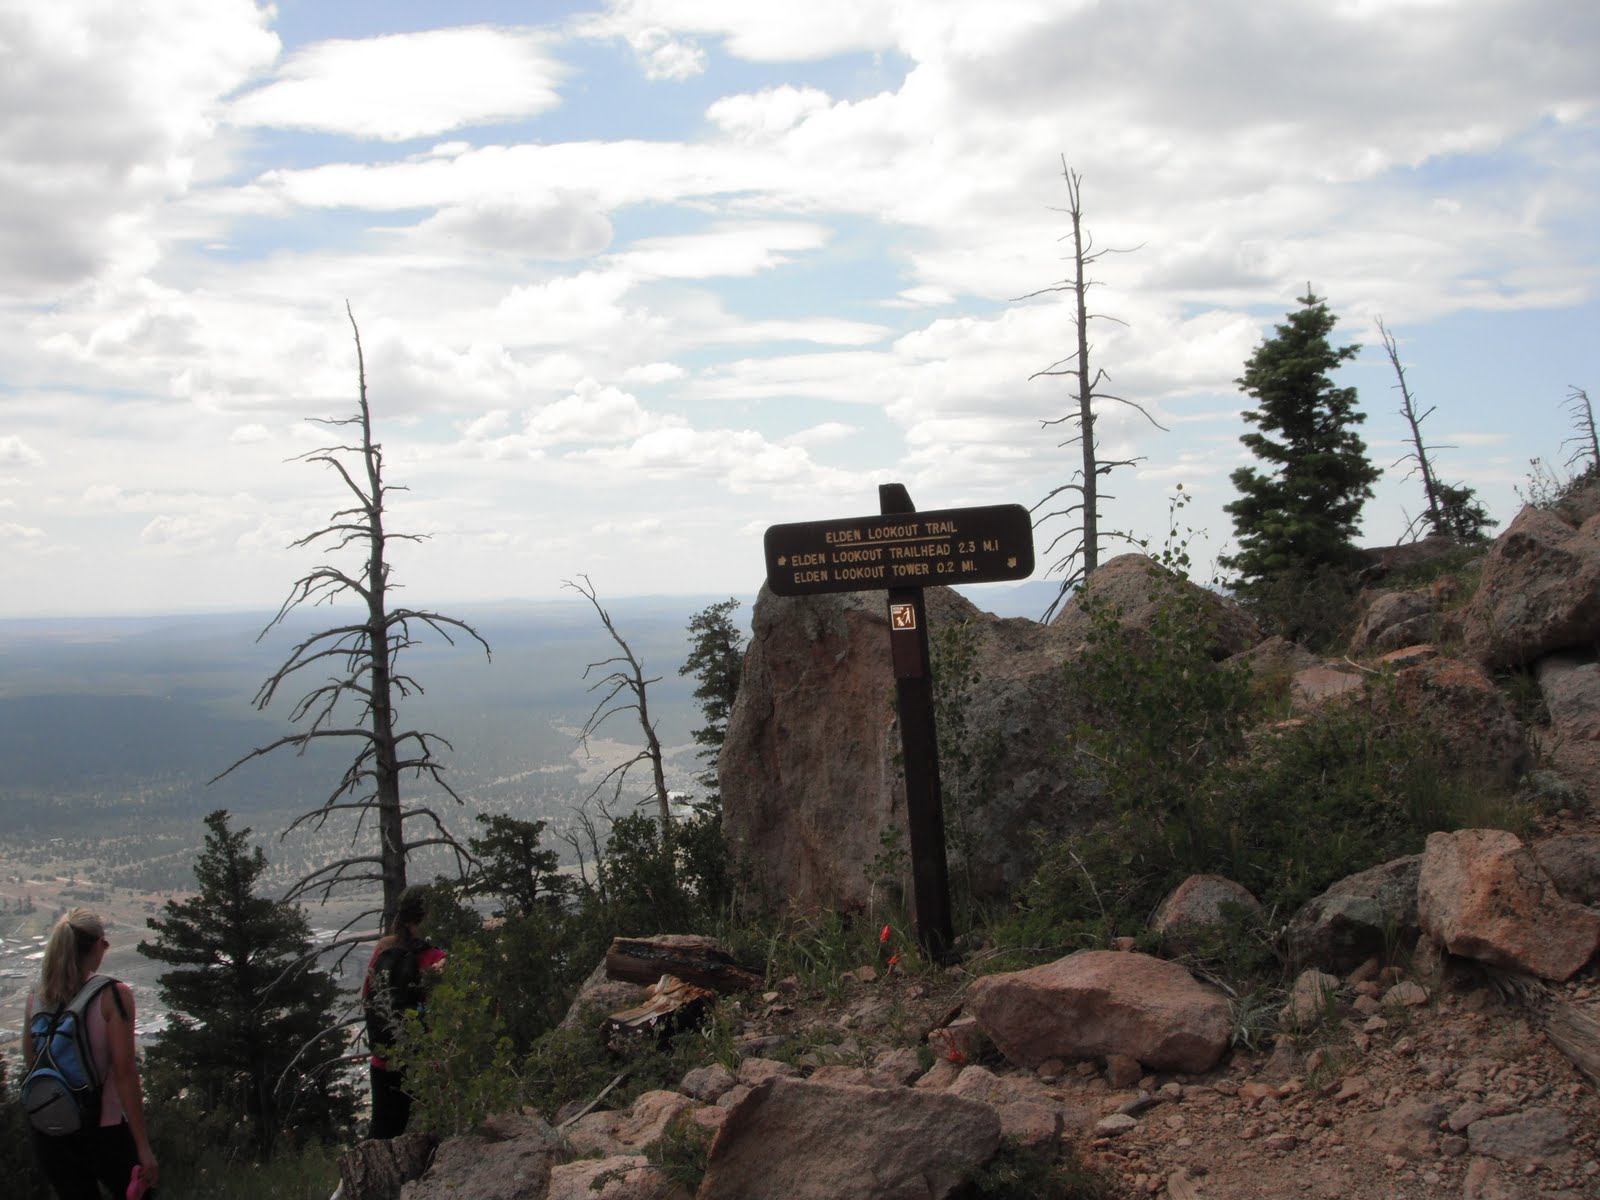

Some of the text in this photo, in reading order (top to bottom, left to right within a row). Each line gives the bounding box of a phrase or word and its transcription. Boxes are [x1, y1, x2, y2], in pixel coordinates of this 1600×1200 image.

[826, 521, 957, 543] ELDEN LOOKOUT TRAIL
[791, 553, 826, 567] ELDEN
[832, 548, 882, 563] LOOKOUT
[889, 544, 950, 559] TRAILHEAD
[958, 541, 976, 554] 2.3
[794, 560, 978, 584] ELDEN LOOKOUT TOWER 0.2 MI.
